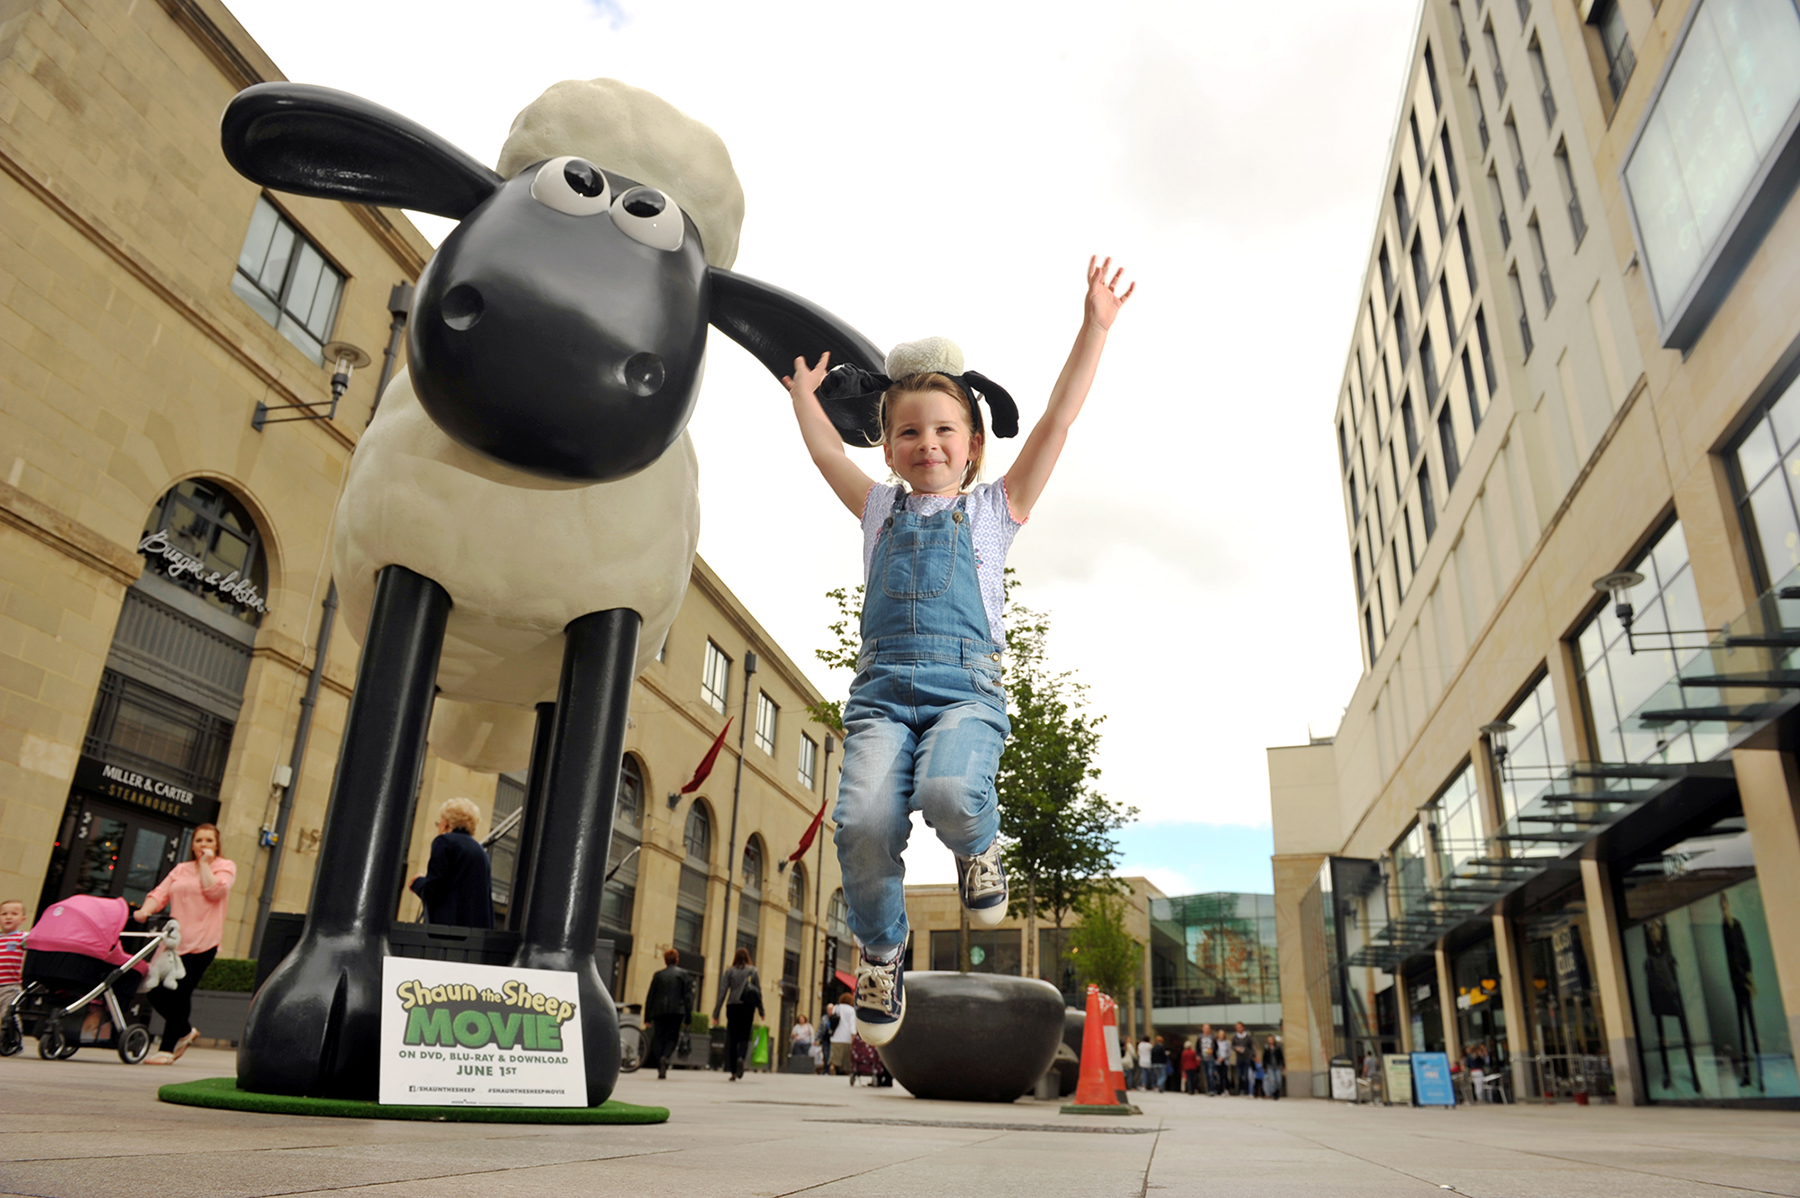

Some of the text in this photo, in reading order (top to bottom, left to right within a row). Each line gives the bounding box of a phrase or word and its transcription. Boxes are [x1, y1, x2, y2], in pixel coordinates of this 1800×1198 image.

[138, 529, 204, 579] Burger
[205, 571, 221, 585] &
[102, 764, 194, 805] MILLER & CARTER
[108, 784, 180, 816] STEAKHOUSE
[397, 979, 574, 1024] Shaun the Sheep
[403, 1006, 563, 1052] MOVIE
[399, 1050, 568, 1064] ON DVD, BLU-RAY & DOWNLOAD
[457, 1065, 517, 1077] JUNE 1ST
